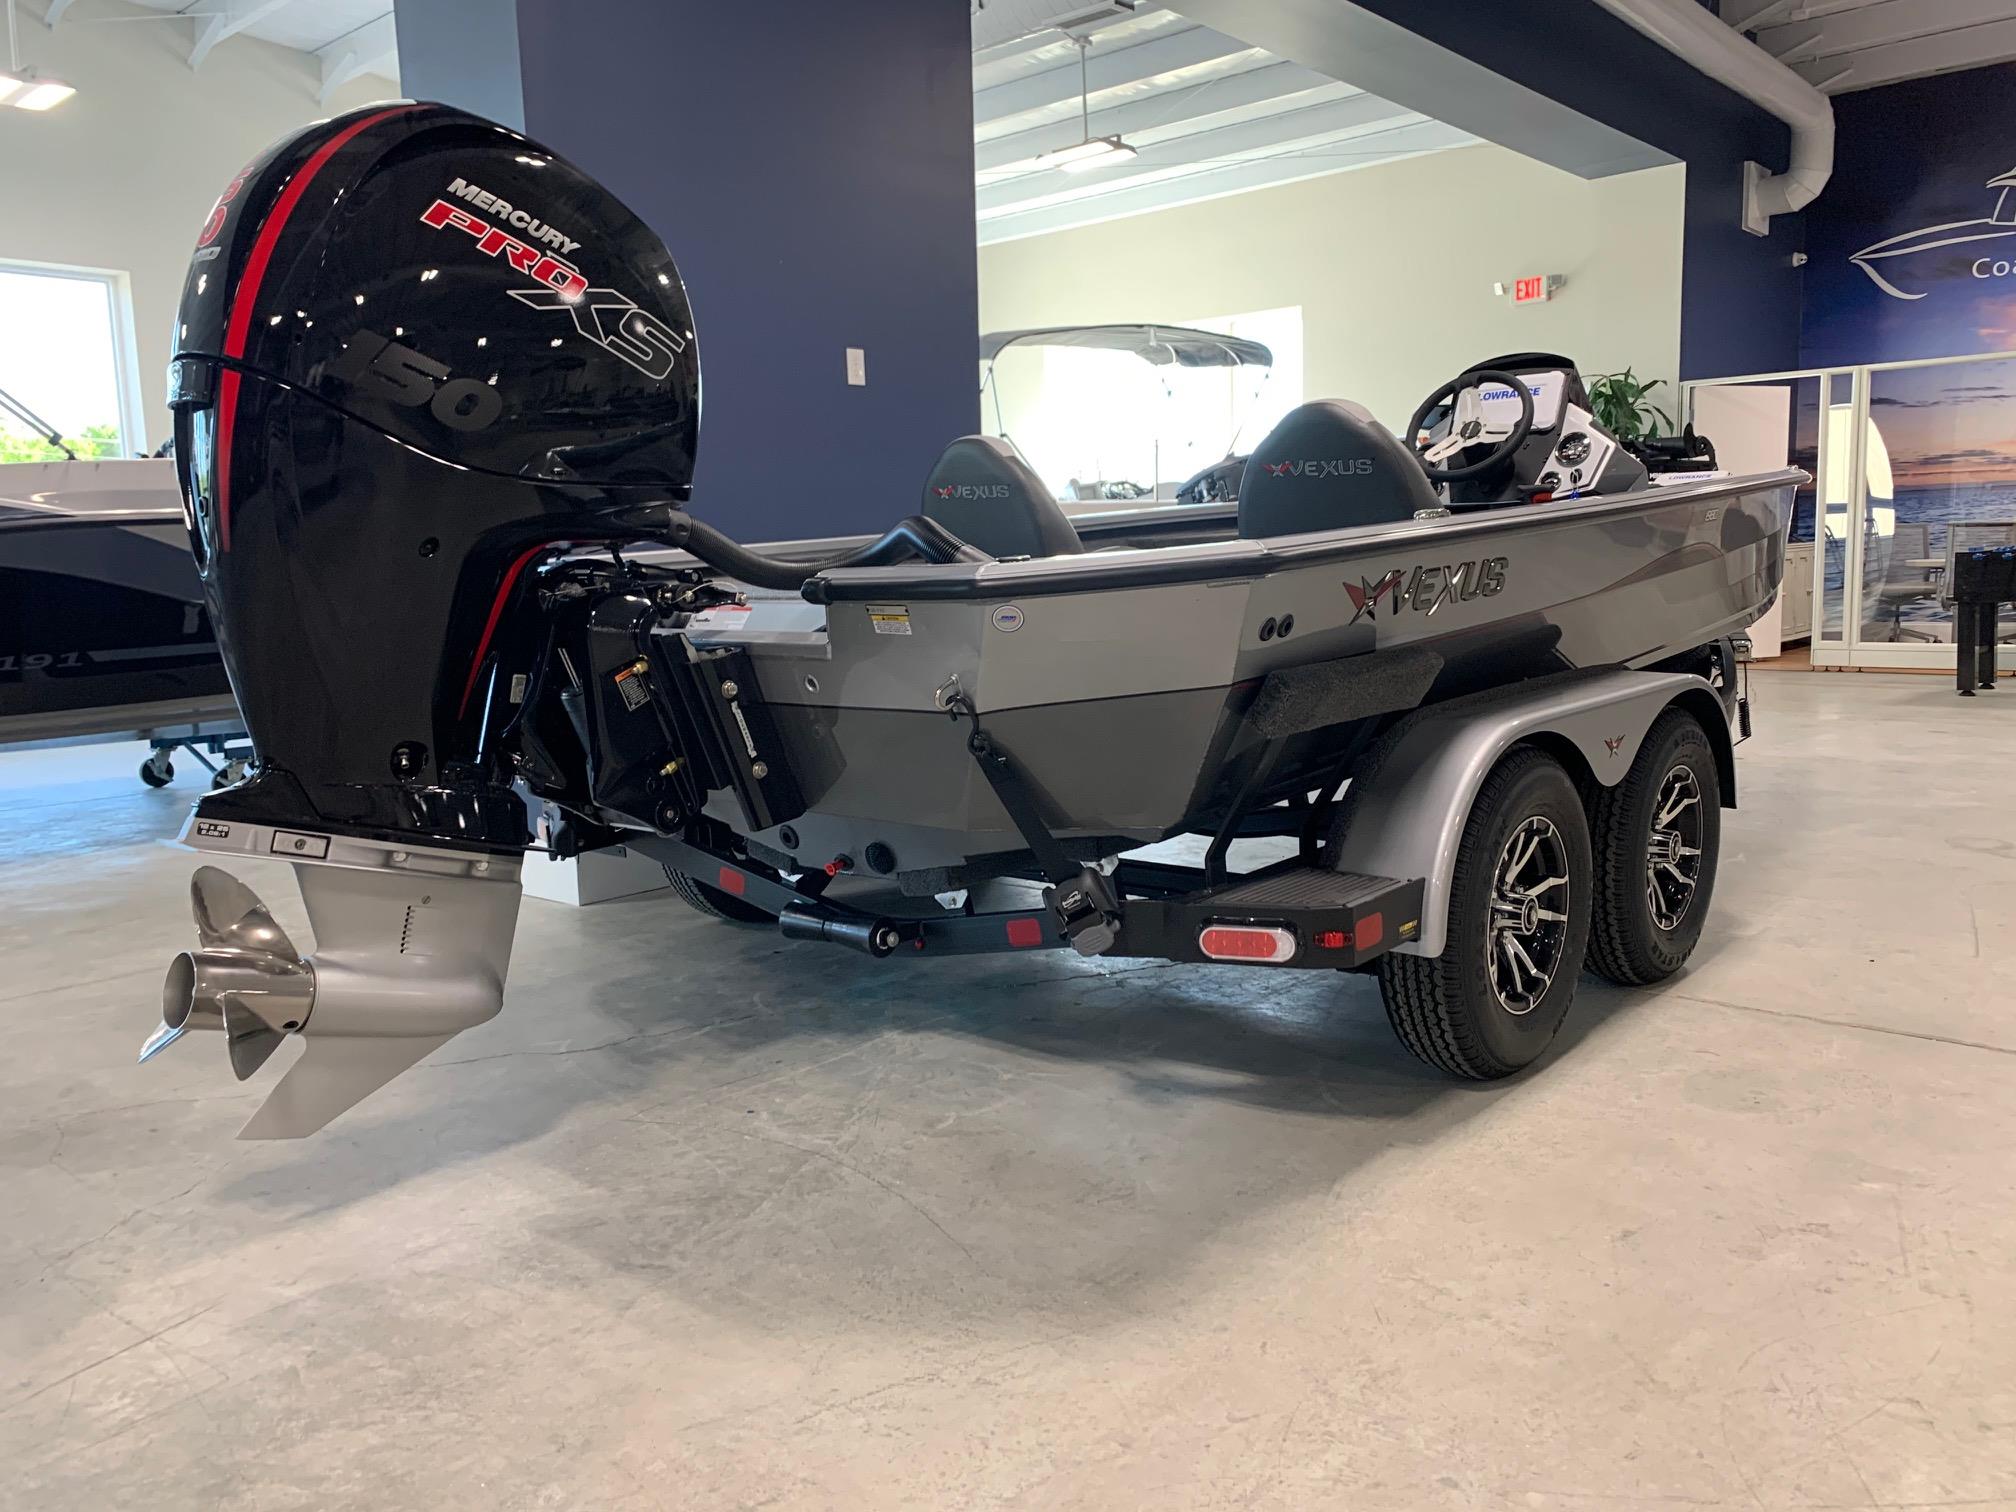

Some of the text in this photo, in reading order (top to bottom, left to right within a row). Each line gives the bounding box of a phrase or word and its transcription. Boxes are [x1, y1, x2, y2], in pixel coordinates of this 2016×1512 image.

[419, 199, 589, 300] PRO
[447, 177, 581, 255] MERCURY
[506, 252, 686, 380] XS
[1516, 277, 1542, 301] EXIT
[325, 329, 502, 432] 150
[952, 484, 1010, 500] VEXUS
[1285, 459, 1374, 479] VEXUS
[1392, 556, 1509, 616] VEXUS
